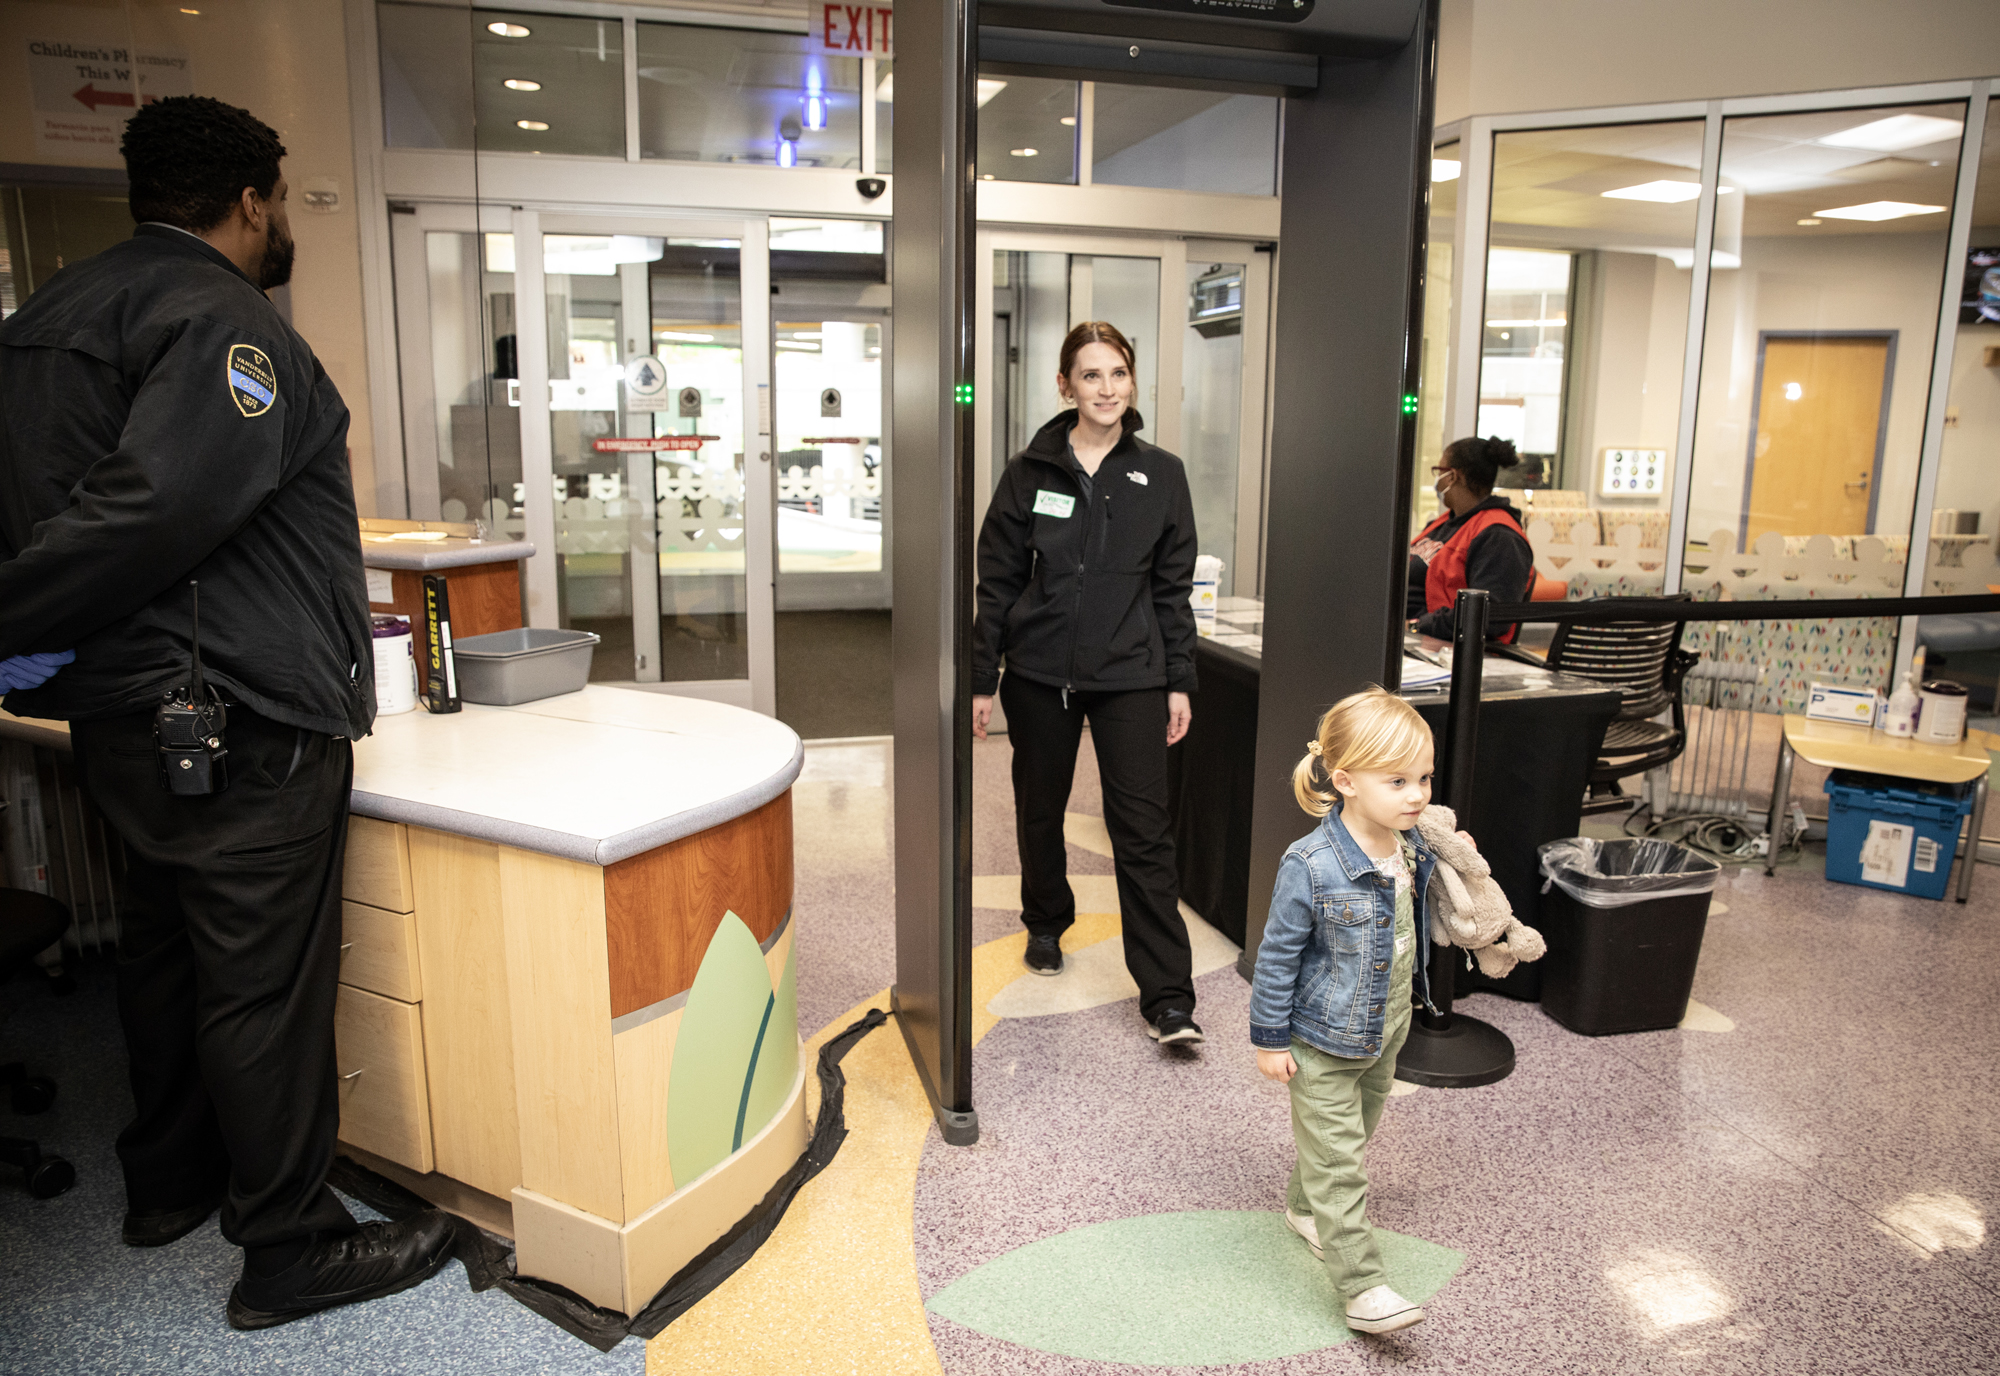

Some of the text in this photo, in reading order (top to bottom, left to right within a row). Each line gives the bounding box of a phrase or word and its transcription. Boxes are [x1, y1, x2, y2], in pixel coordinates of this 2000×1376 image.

[824, 4, 893, 53] EXIT
[29, 41, 110, 63] Children's
[76, 64, 147, 84] This Wy
[234, 362, 273, 389] UNIVERSITY
[236, 355, 273, 383] VANDERBILT
[240, 377, 266, 398] CSO
[242, 398, 257, 410] 1873
[243, 393, 258, 405] SINCE
[1048, 496, 1070, 505] VISITOR
[427, 588, 440, 669] GARRETT
